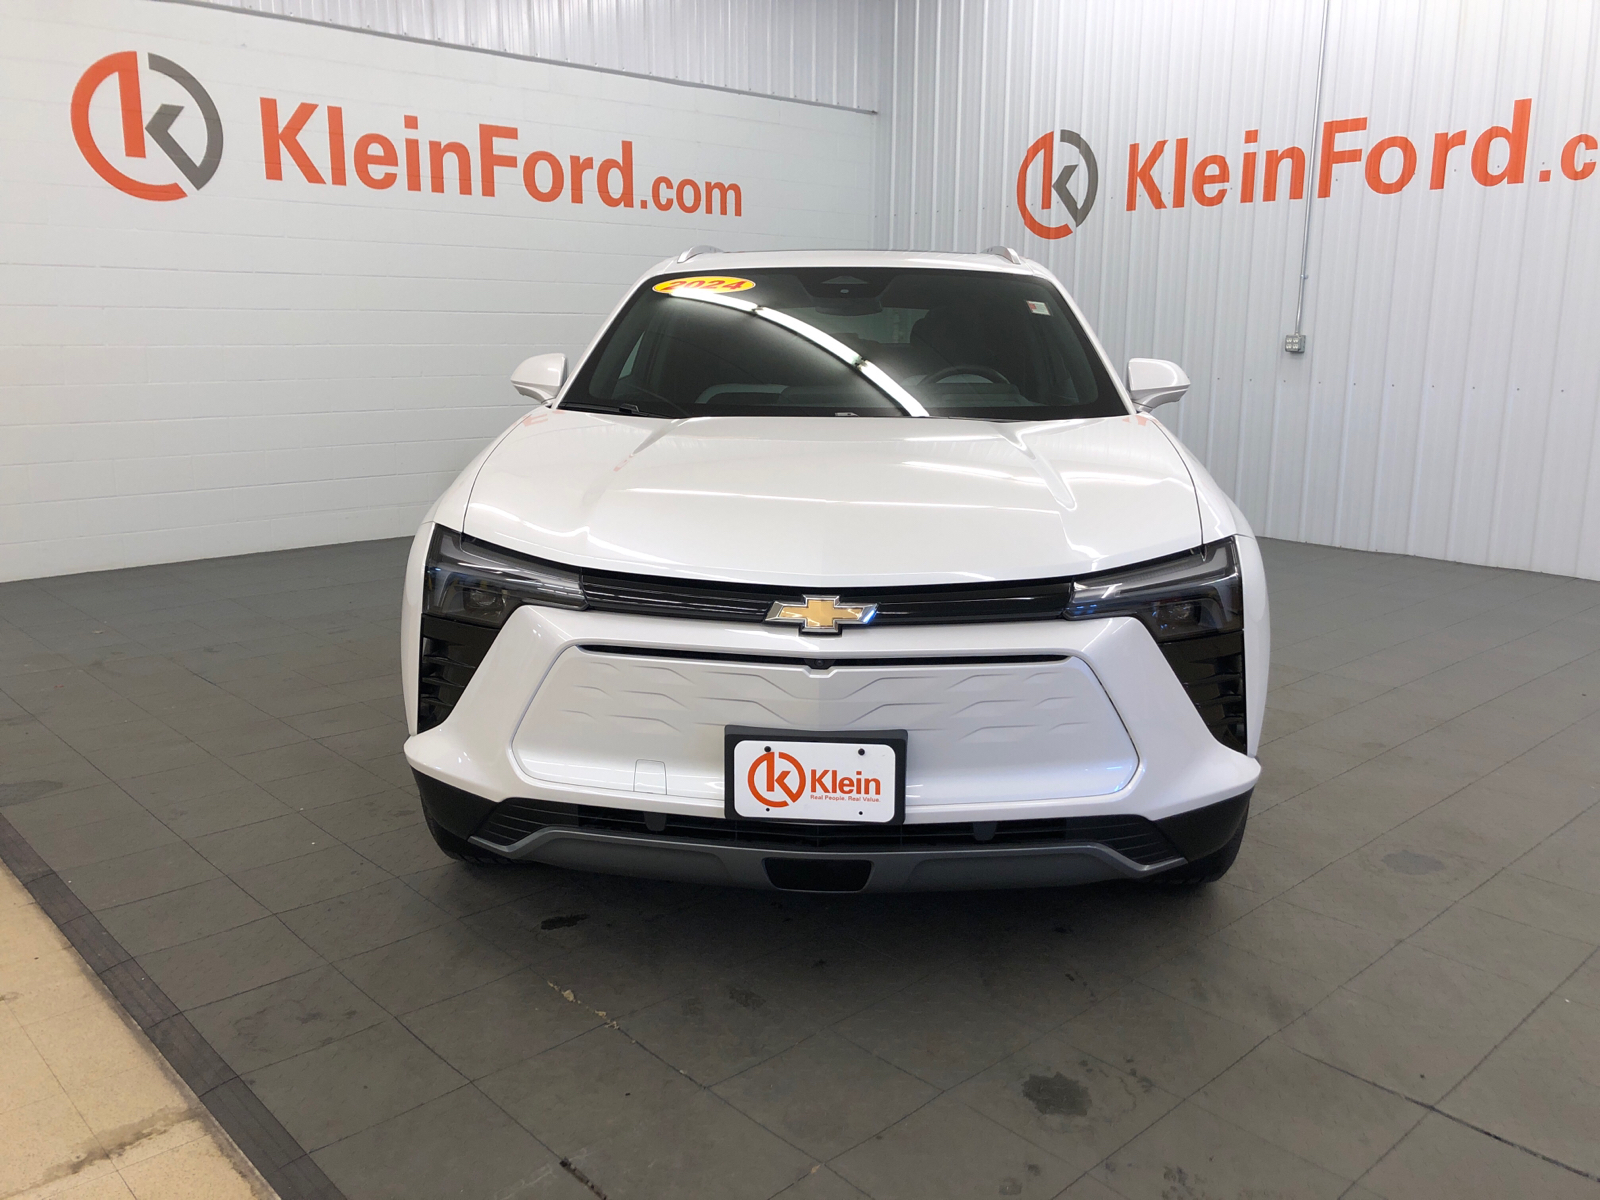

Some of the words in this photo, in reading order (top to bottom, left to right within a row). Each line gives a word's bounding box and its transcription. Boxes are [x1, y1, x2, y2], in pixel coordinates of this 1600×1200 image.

[259, 96, 743, 218] KleinFord.com
[660, 280, 747, 290] 2024
[810, 769, 881, 795] Klein
